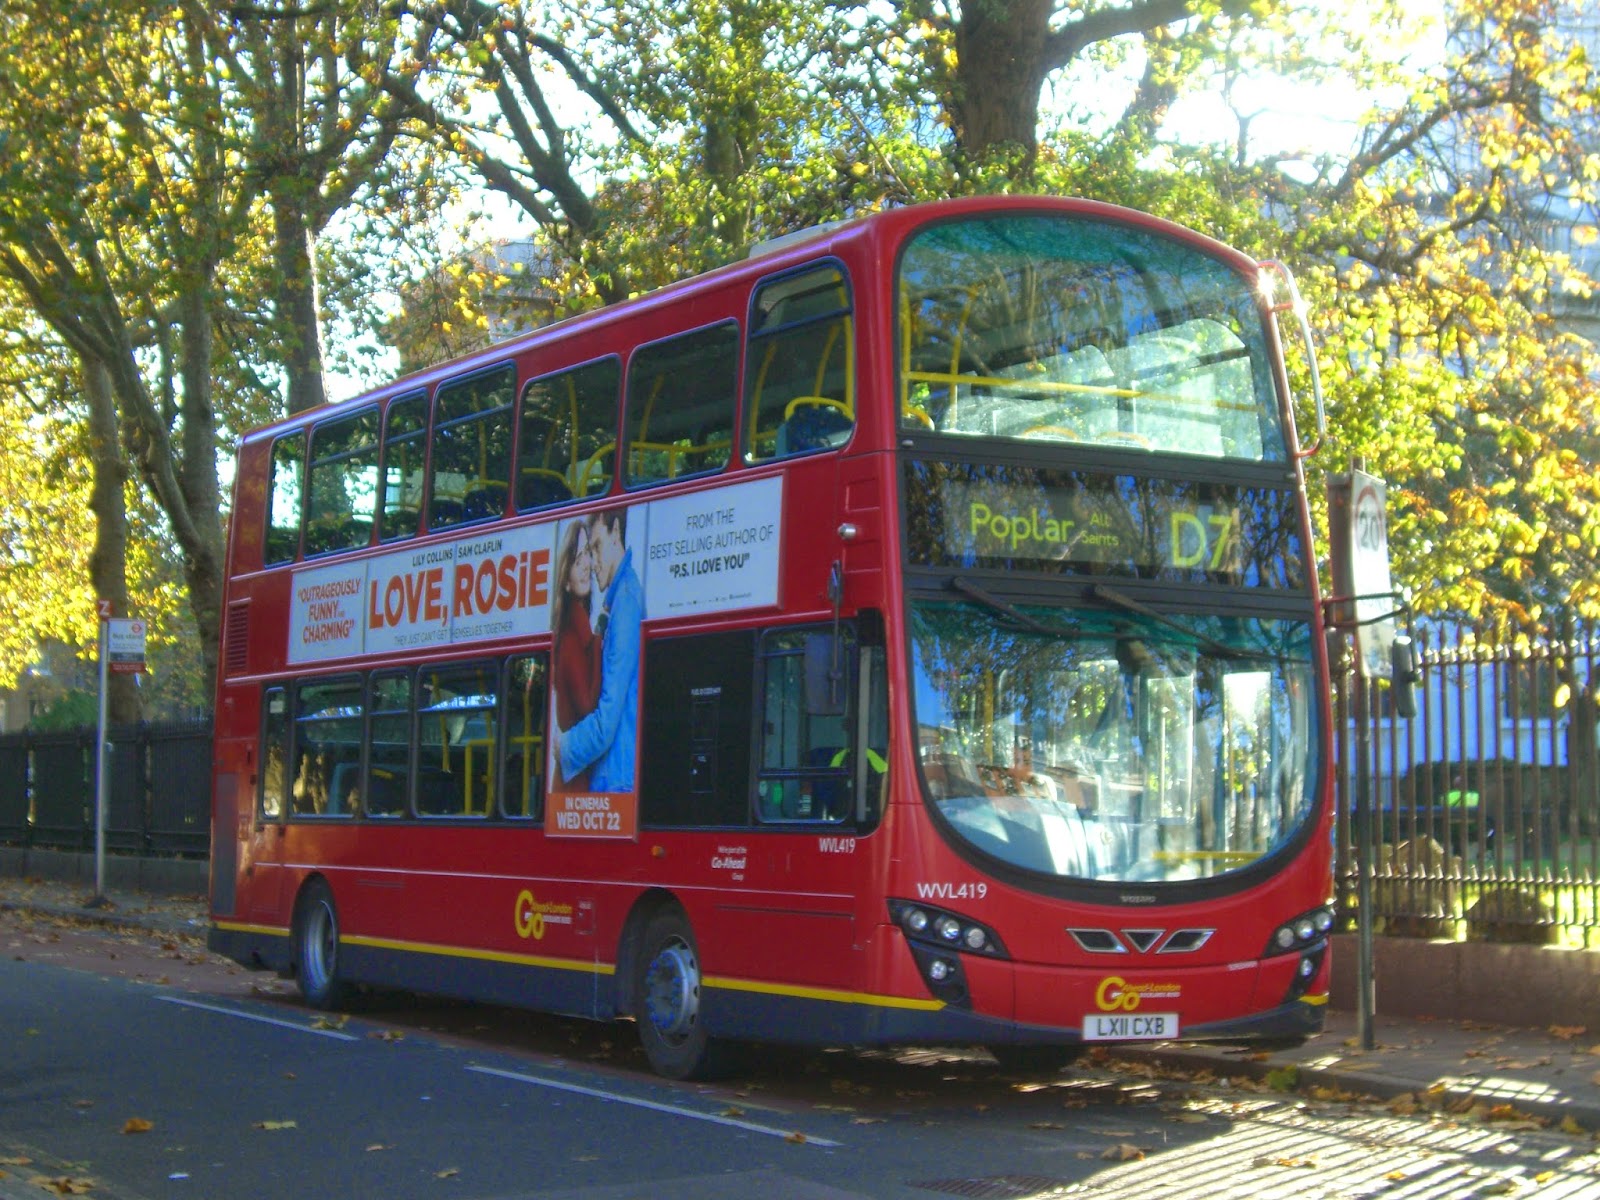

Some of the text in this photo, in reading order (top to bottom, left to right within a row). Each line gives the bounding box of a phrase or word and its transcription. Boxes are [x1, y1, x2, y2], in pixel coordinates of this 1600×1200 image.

[686, 508, 735, 530] FROM THE
[970, 502, 1233, 568] Poplar D7
[1081, 530, 1119, 547] Saints
[1359, 511, 1380, 551] 20
[458, 539, 503, 558] SAM CLAFLIN
[650, 524, 774, 560] BEST SELLING AUTHOR OF
[412, 548, 453, 567] LILY COLLINS
[696, 557, 721, 575] LOVE
[369, 567, 449, 629] LOVE,
[98, 600, 110, 617] Z
[308, 600, 339, 621] FUNNY
[483, 620, 513, 635] TOGETHER
[565, 797, 610, 810] IN CINEMAS
[556, 812, 620, 830] WED OCT 22
[819, 838, 856, 853] WVL419
[711, 857, 747, 869] Go-Ahead
[918, 883, 988, 899] WVL419
[515, 890, 544, 940] Go
[1096, 976, 1140, 1011] Go
[1133, 1017, 1164, 1036] CXB
